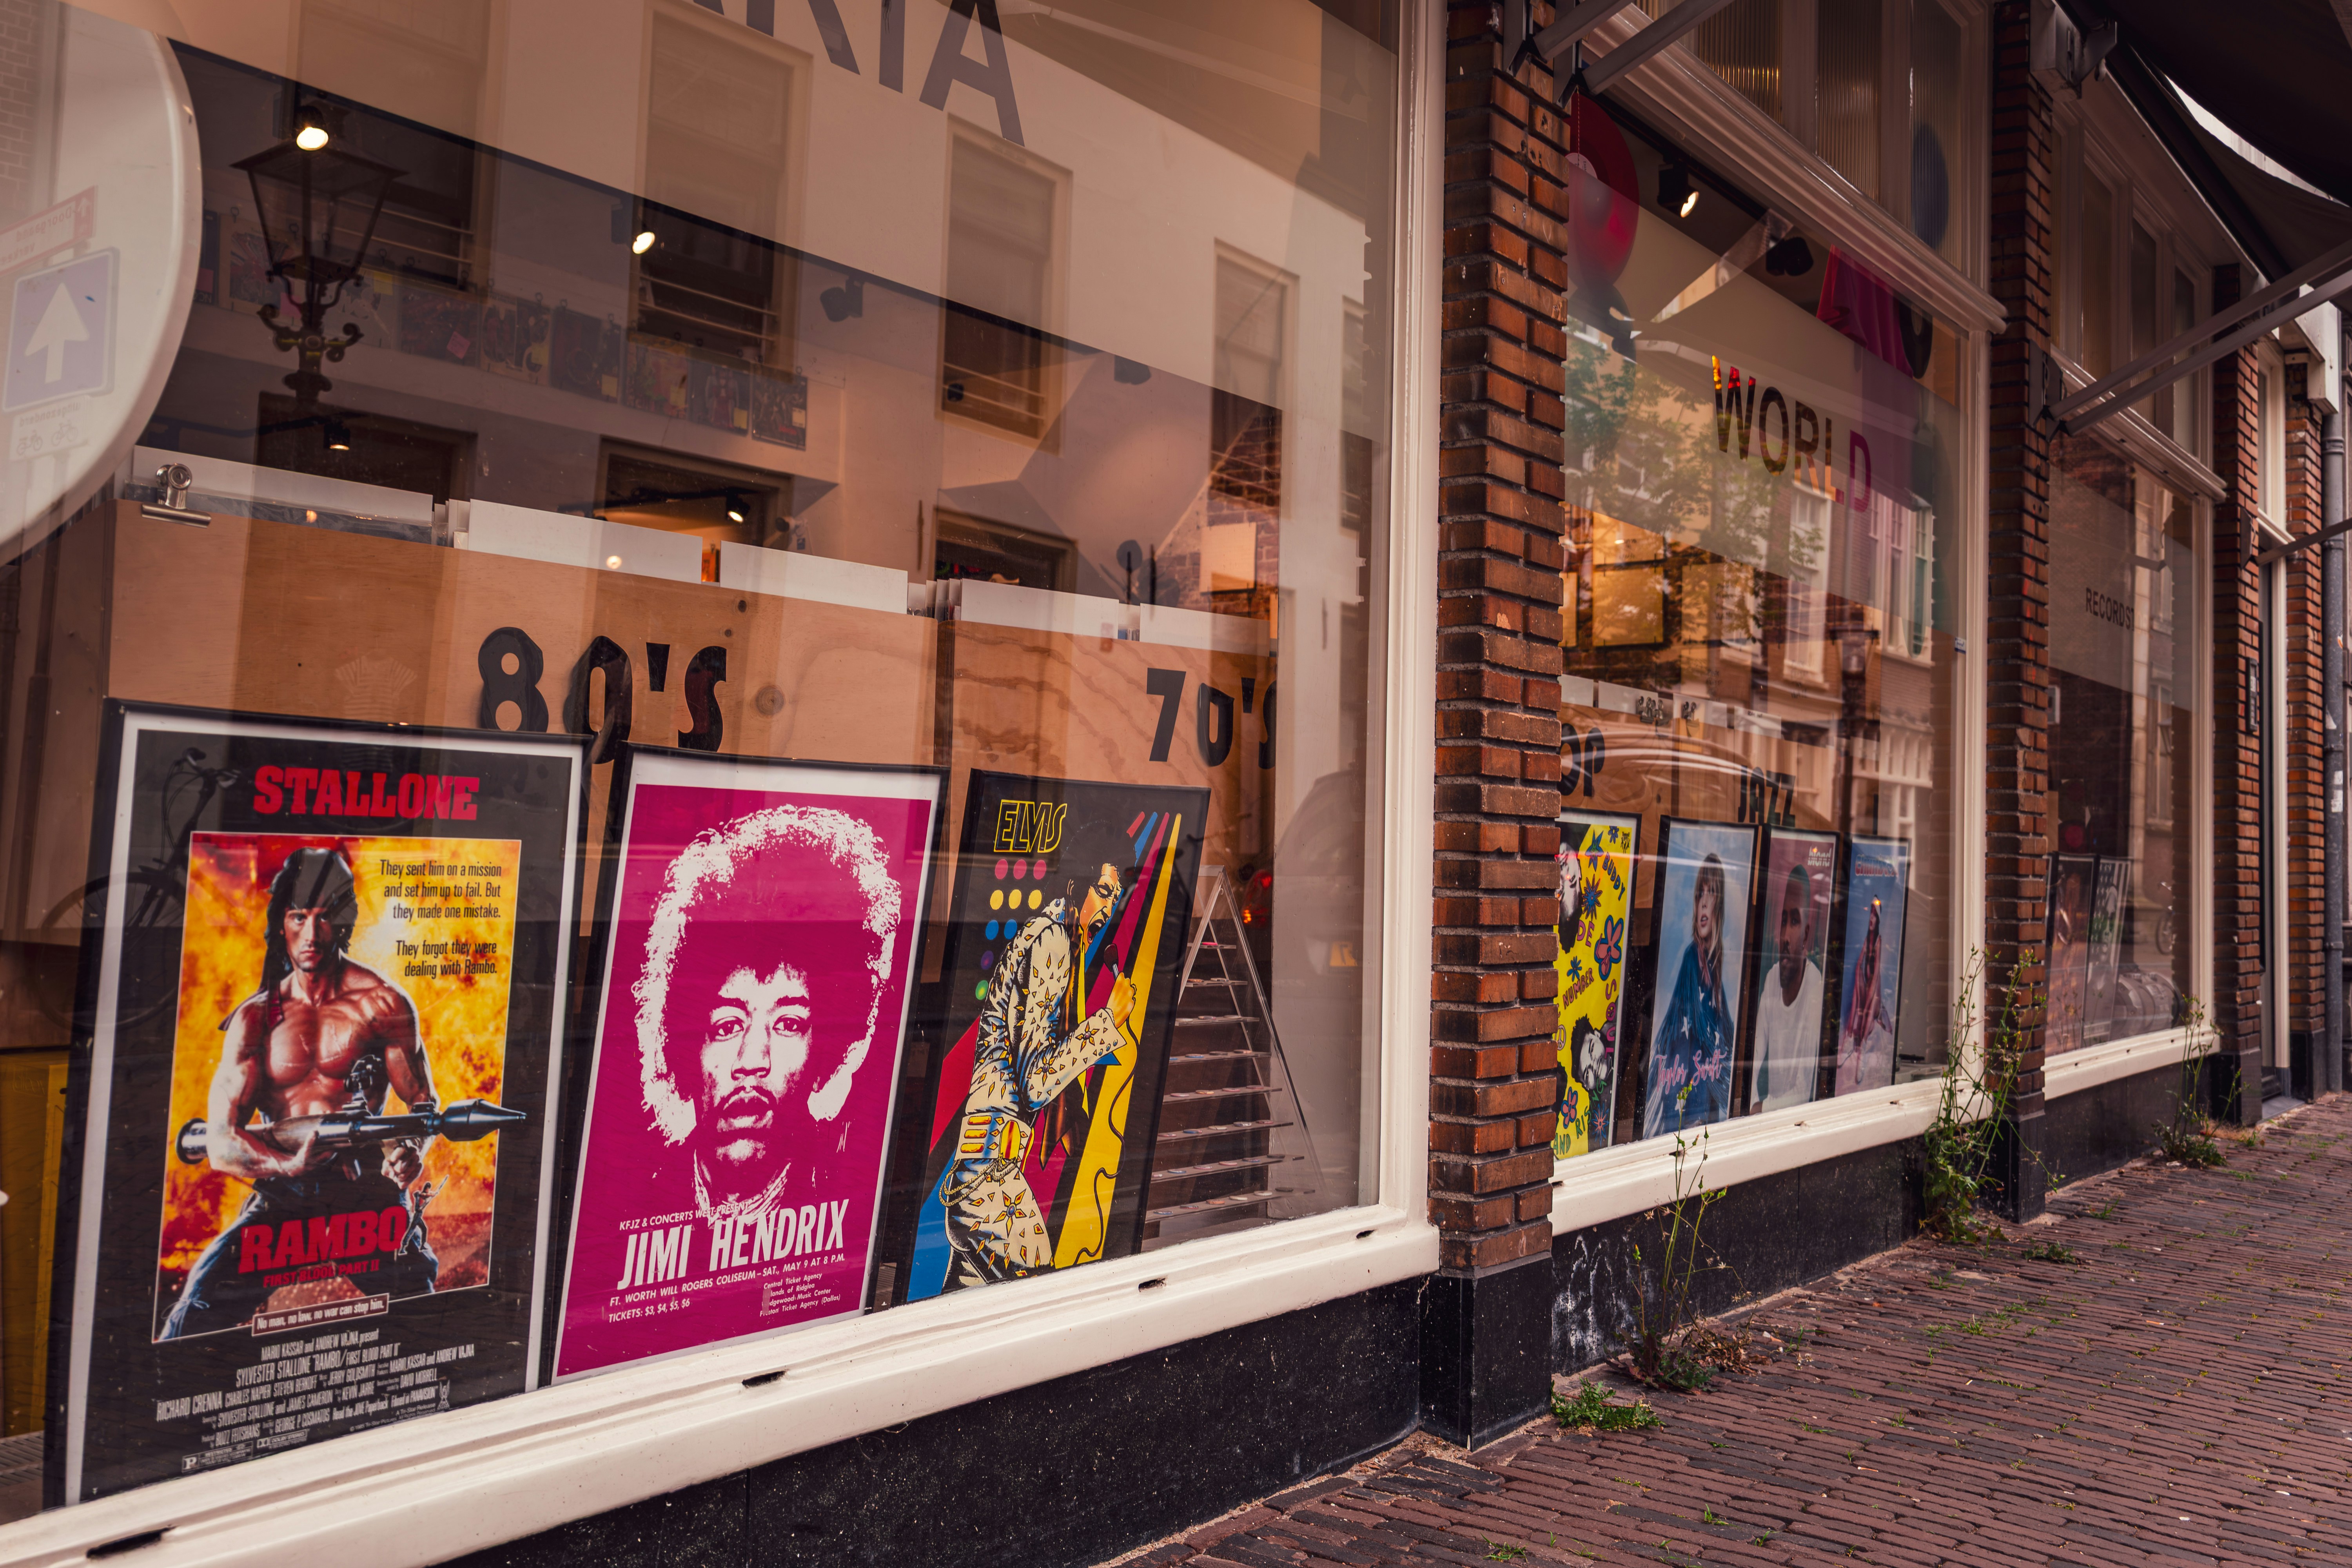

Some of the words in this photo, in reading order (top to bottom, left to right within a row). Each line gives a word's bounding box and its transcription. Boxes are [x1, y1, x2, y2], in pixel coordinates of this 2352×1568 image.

[1711, 355, 1871, 513] WORLD
[253, 765, 479, 820] STALLONE
[1738, 765, 1796, 827] JAZZ
[994, 799, 1067, 853] ELVIS
[380, 859, 403, 879] They
[406, 862, 425, 876] sent
[428, 860, 444, 876] him
[447, 865, 457, 876] on
[461, 866, 465, 876] a
[468, 862, 501, 877] mission
[1602, 852, 1625, 901] BUDDY
[384, 882, 402, 897] and
[405, 884, 419, 897] set
[422, 882, 437, 897] him
[440, 886, 450, 900] up
[454, 884, 462, 897] to
[466, 882, 482, 897] fail.
[486, 882, 501, 897] But
[393, 903, 414, 922] they
[417, 903, 441, 918] made
[445, 907, 461, 918] one
[464, 903, 501, 918] mistake.
[396, 940, 419, 959] They
[423, 940, 448, 958] forgot
[452, 939, 471, 956] they
[475, 943, 497, 953] were
[405, 961, 437, 979] dealing
[440, 960, 461, 975] with
[465, 959, 497, 974] Rambo.
[1563, 967, 1594, 1010] NUMBER
[1577, 920, 1595, 947] DE
[1605, 979, 1616, 1059] SOUL
[1655, 1054, 1687, 1094] Taylor
[1693, 1049, 1727, 1085] Swift
[1553, 1133, 1571, 1155] AND
[1575, 1078, 1607, 1139] RISING
[620, 1219, 640, 1230] KFJZ
[642, 1218, 648, 1227] &
[650, 1211, 693, 1226] CONCERTS
[238, 1206, 407, 1274] RAMBO
[617, 1224, 692, 1290] JIMI
[709, 1199, 849, 1272] HENDRIX
[263, 1271, 298, 1288] FIRST
[299, 1265, 336, 1283] BLOOD
[339, 1261, 368, 1276] PART
[370, 1259, 379, 1271] II
[610, 1296, 621, 1306] FT.
[625, 1290, 656, 1303] WORTH
[660, 1286, 677, 1296] WILL
[682, 1278, 713, 1292] ROGERS
[716, 1270, 755, 1285] COLISEUM
[783, 1261, 801, 1272] MAY
[811, 1258, 820, 1267] AT
[824, 1256, 828, 1264] 8
[831, 1253, 845, 1263] P.M.
[764, 1279, 783, 1289] Central
[804, 1273, 822, 1282] Agency
[796, 1283, 815, 1292] Ridglea
[609, 1308, 643, 1323] TICKETS:
[645, 1306, 655, 1317] $3,
[657, 1303, 668, 1314] $4,
[670, 1301, 679, 1312] $5,
[681, 1298, 690, 1309] $6
[797, 1292, 811, 1300] Music
[800, 1300, 818, 1308] Agency
[822, 1294, 840, 1305] (Dallas)
[257, 1318, 267, 1330] No
[269, 1317, 285, 1328] man,
[288, 1315, 296, 1324] no
[298, 1311, 312, 1323] law,
[314, 1310, 323, 1319] no
[324, 1307, 338, 1317] war
[339, 1305, 352, 1315] can
[354, 1302, 369, 1315] stop
[370, 1299, 384, 1310] him.
[281, 1339, 304, 1357] KASSAR
[304, 1338, 314, 1352] and
[315, 1333, 340, 1351] ANDREW
[236, 1362, 275, 1388] SYLVESTER
[277, 1355, 311, 1379] STALLONE
[157, 1397, 190, 1421] RICHARD
[192, 1390, 222, 1414] CRENNA
[225, 1388, 249, 1407] CHARLES
[250, 1384, 271, 1402] NAPIER
[273, 1379, 294, 1397] STEVEN
[218, 1407, 246, 1428] SYLVESTER
[247, 1401, 275, 1421] STALLONE
[275, 1399, 286, 1414] and
[286, 1394, 306, 1412] JAMES
